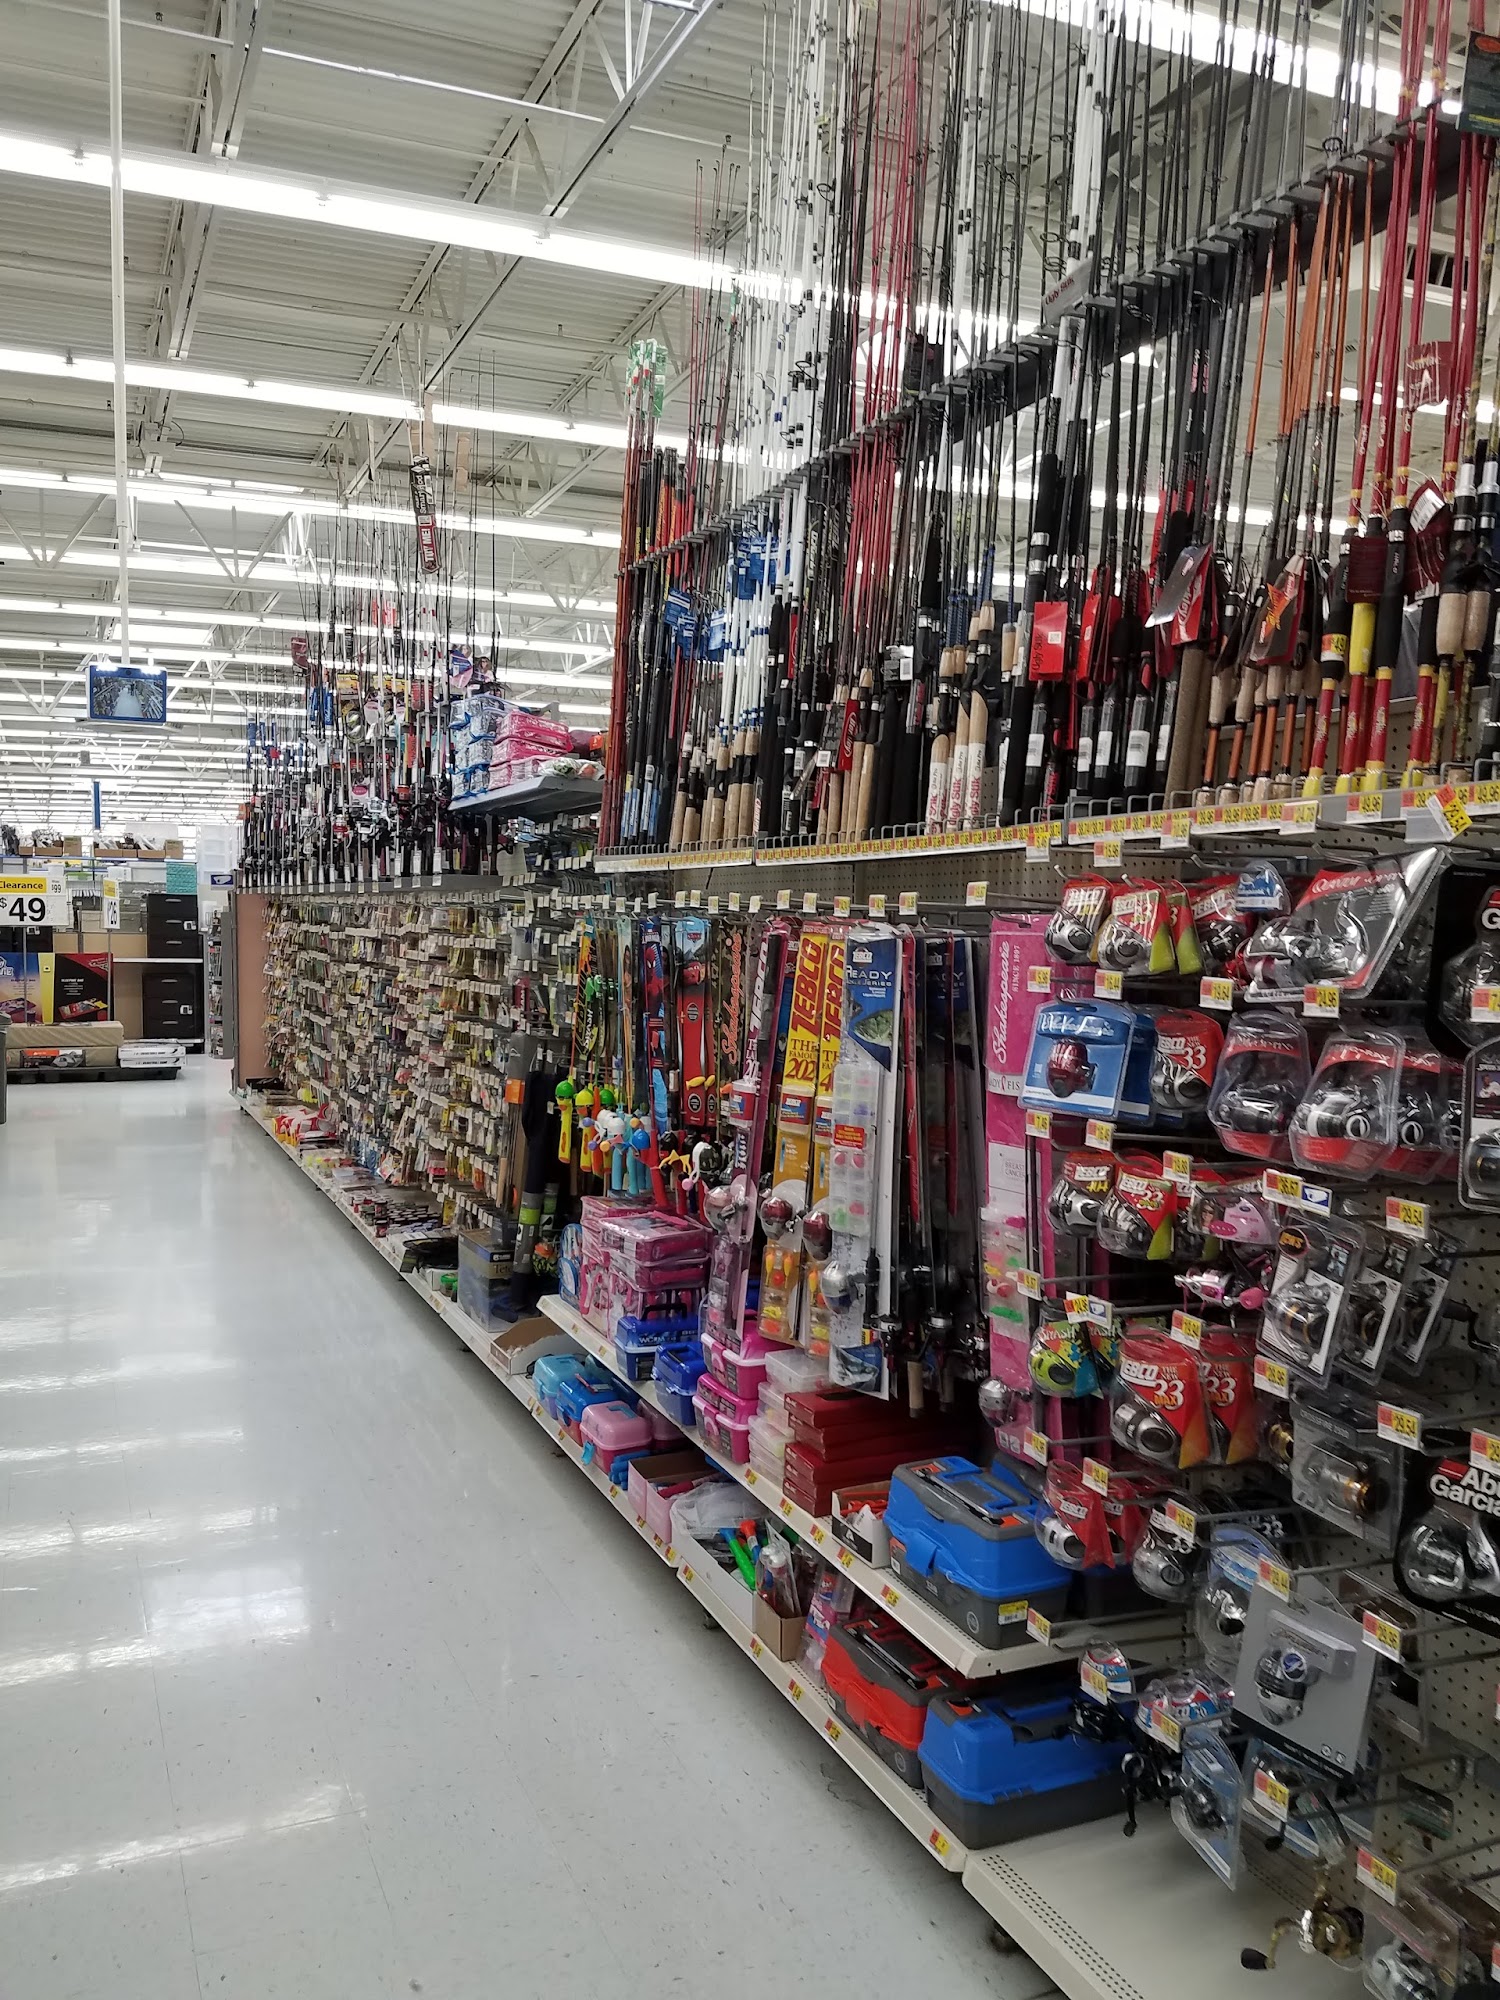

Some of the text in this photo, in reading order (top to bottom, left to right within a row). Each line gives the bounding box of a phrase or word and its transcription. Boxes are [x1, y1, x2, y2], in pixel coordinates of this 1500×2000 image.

[791, 937, 822, 1036] ZEBCO
[993, 940, 1012, 1064] Shakespeare
[789, 1051, 816, 1060] FAMOU
[1183, 1046, 1207, 1069] 33
[785, 1058, 816, 1081] 202
[1154, 1379, 1185, 1410] 33
